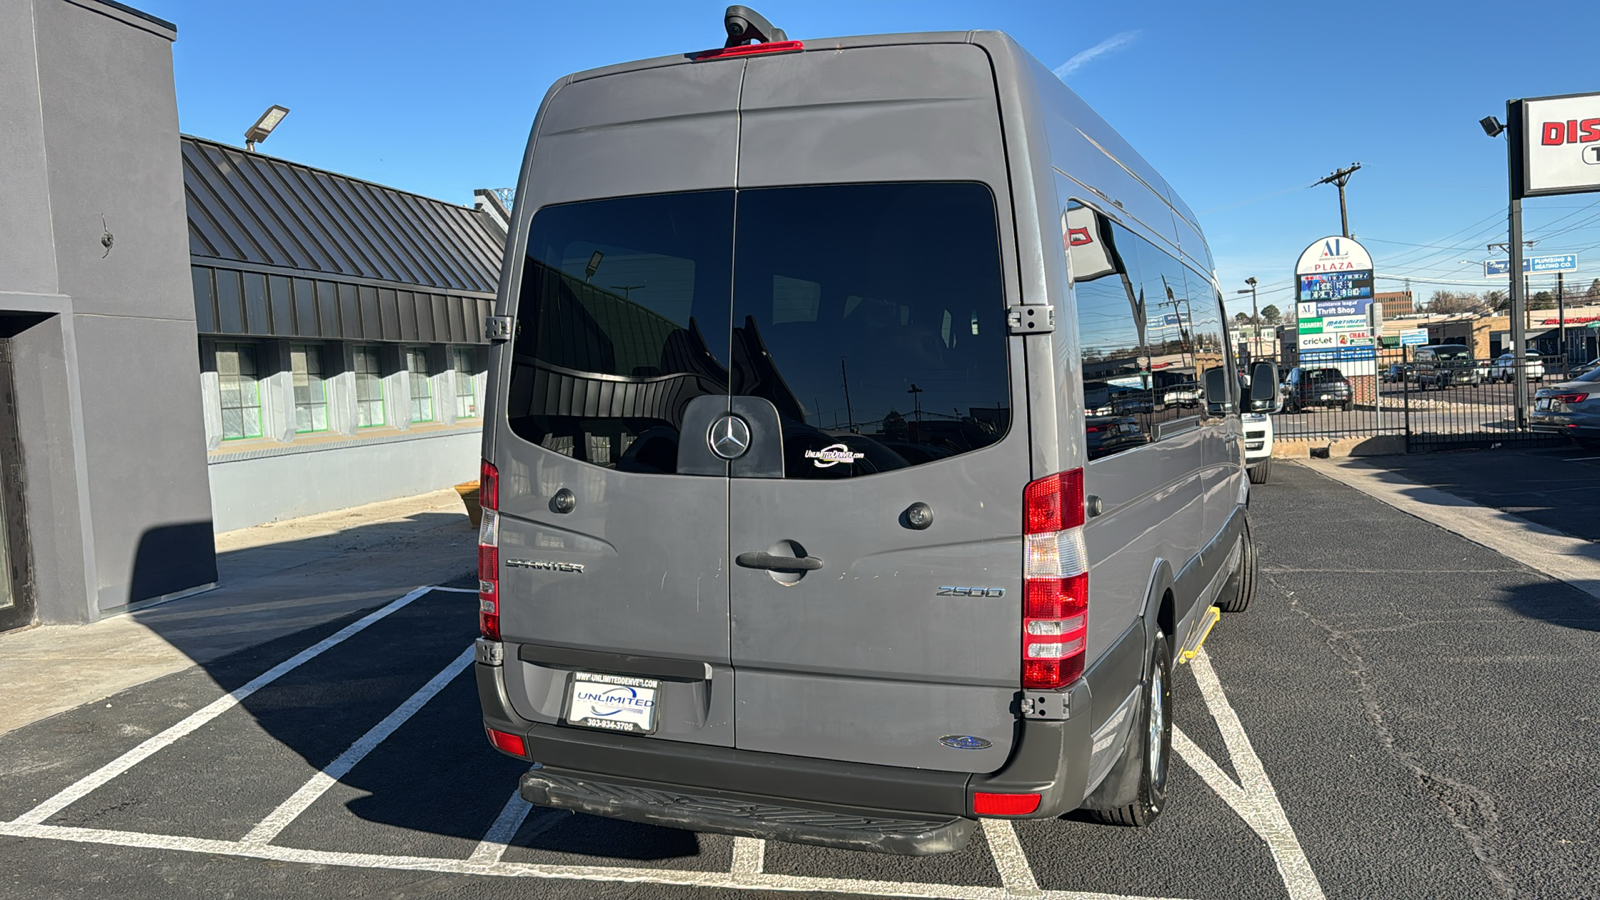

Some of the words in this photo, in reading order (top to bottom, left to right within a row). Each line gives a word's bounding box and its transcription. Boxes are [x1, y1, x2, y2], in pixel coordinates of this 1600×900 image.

[1314, 262, 1354, 272] PLAZA
[1341, 299, 1357, 307] league
[1317, 307, 1336, 315] Thrift
[1337, 306, 1356, 314] Shop
[1303, 336, 1333, 346] cricket
[505, 559, 585, 574] SPRINTER
[936, 586, 1006, 598] 2500
[578, 692, 654, 707] UNLIMITED
[587, 719, 633, 731] 303-934-3705
